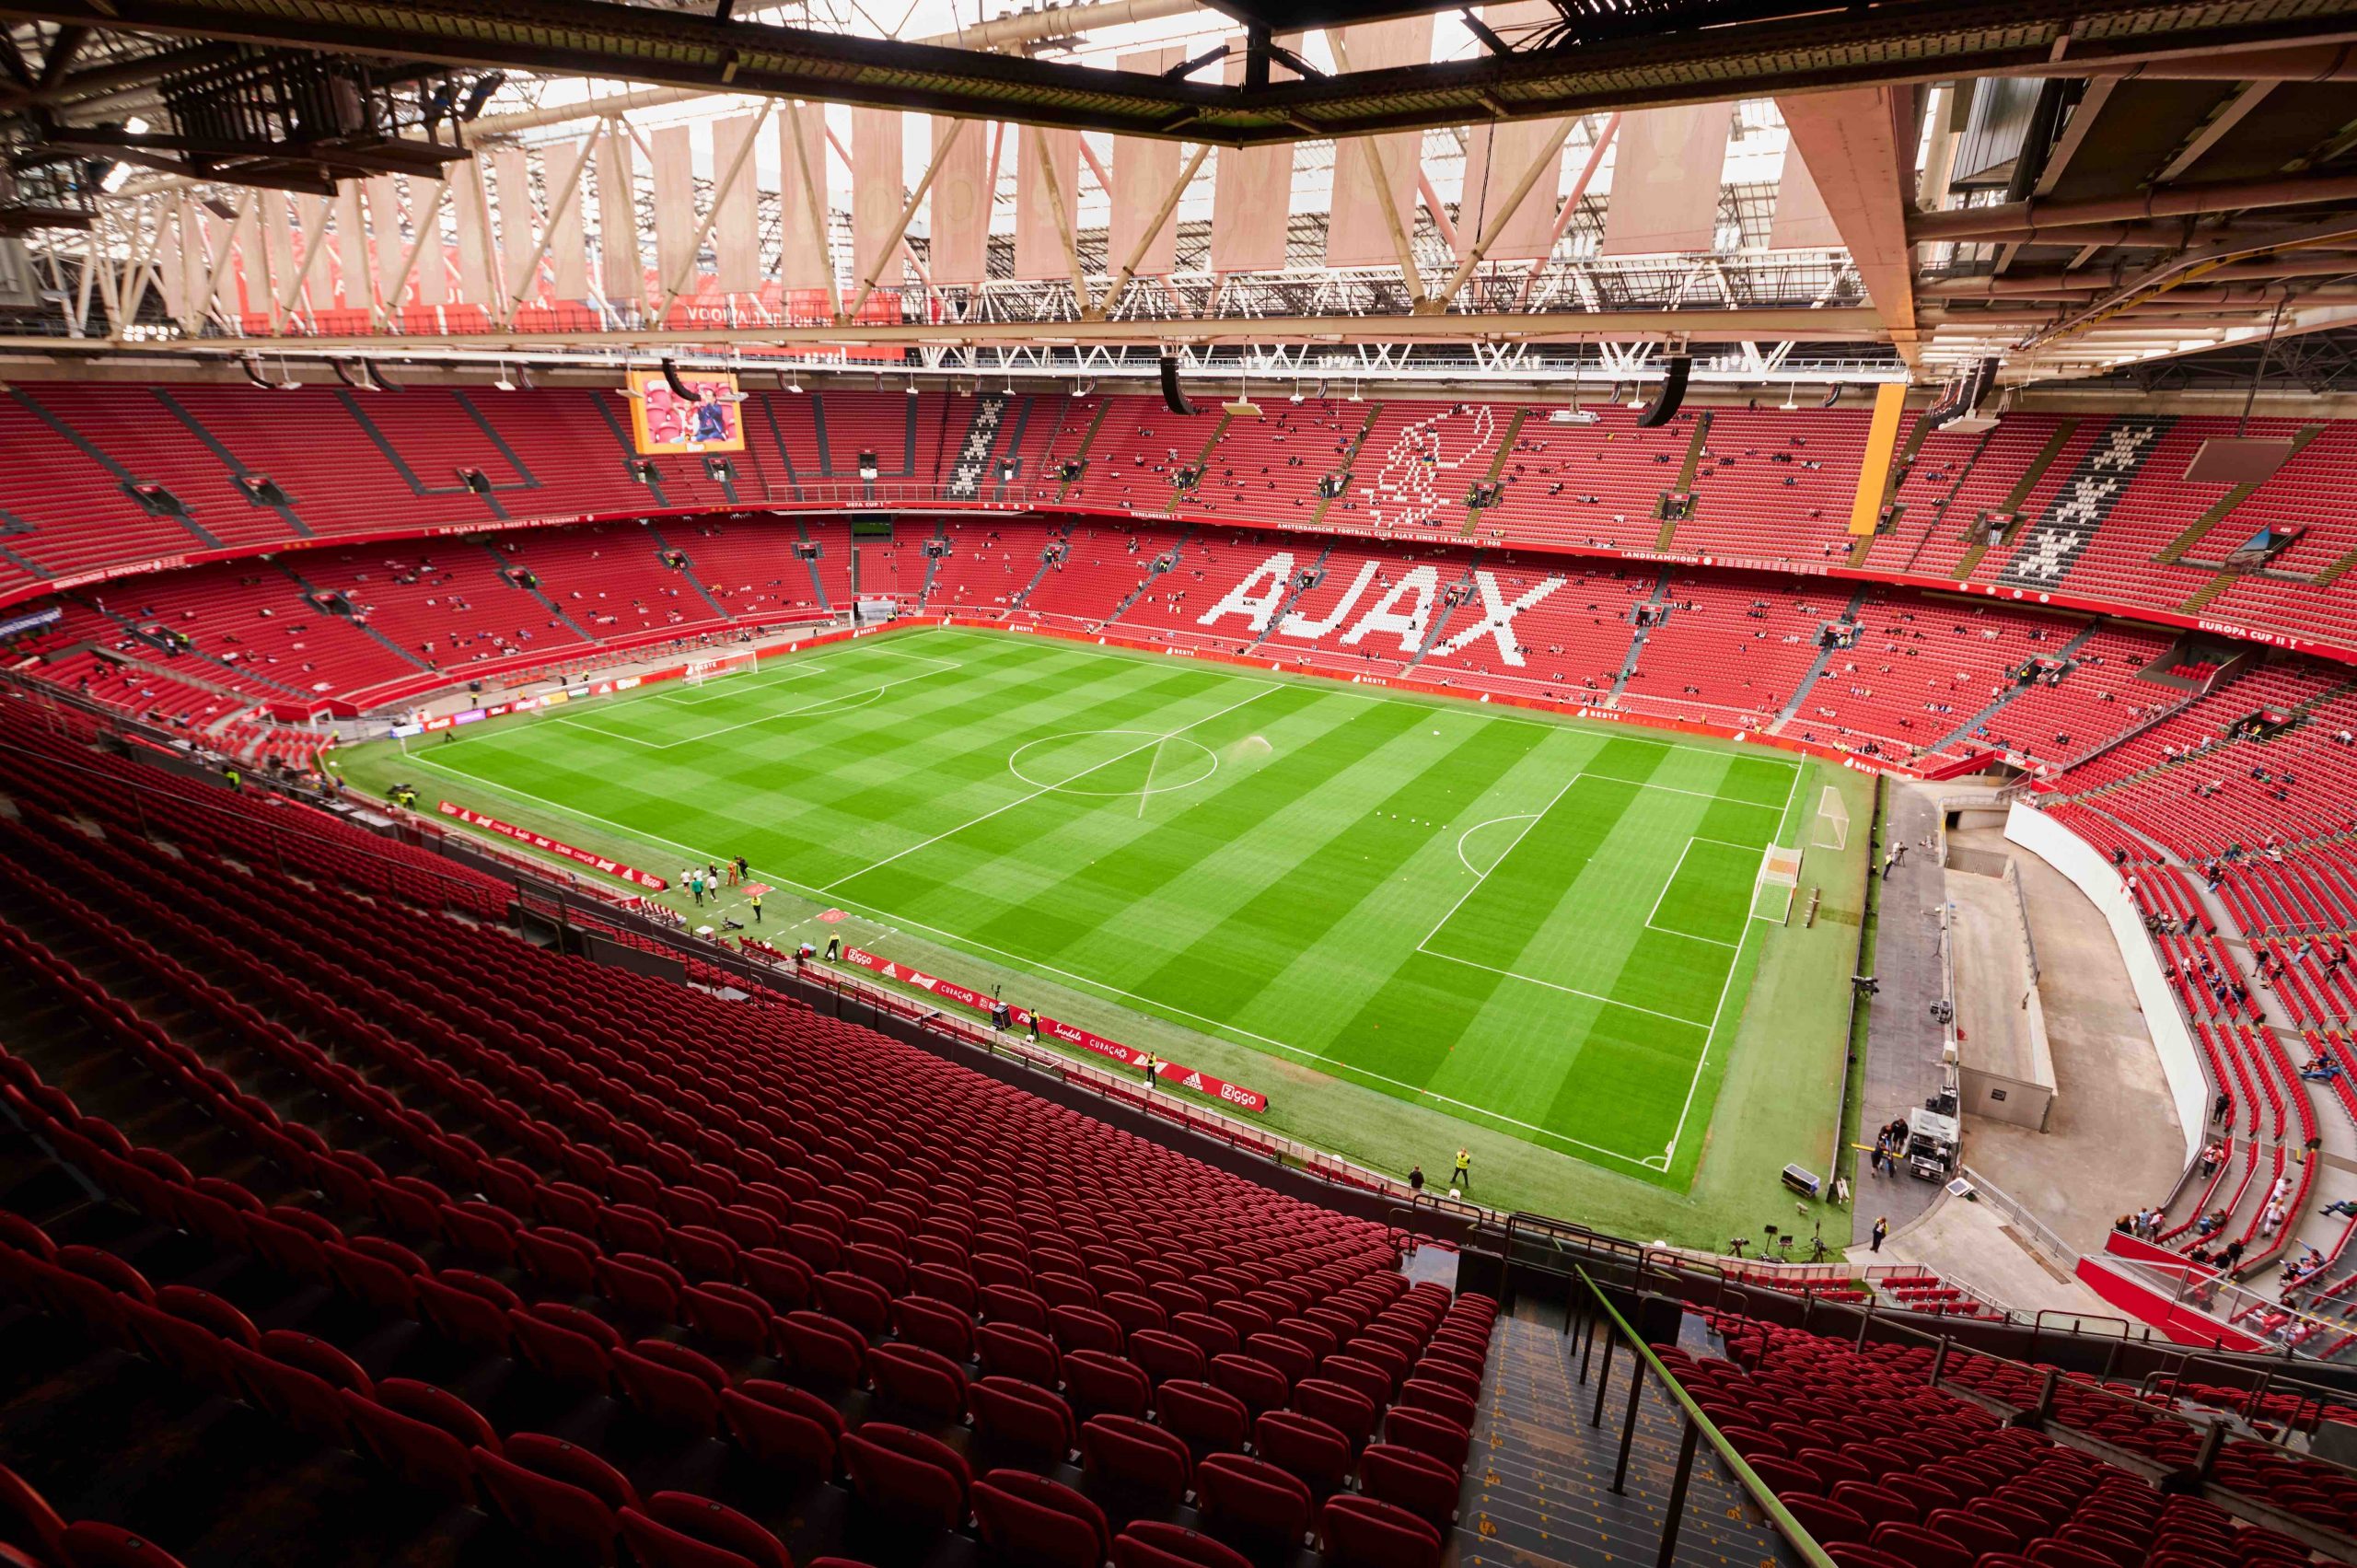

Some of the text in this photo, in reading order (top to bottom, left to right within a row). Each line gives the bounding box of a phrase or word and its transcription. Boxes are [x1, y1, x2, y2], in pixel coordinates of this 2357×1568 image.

[1337, 528, 1371, 537] FOOTBALL
[1374, 529, 1392, 538] CLUB
[1450, 537, 1478, 545] MAART
[1620, 551, 1699, 564] LANDSKAMPIOEN
[1196, 552, 1568, 668] AJAX
[2198, 620, 2247, 637] EUROPA
[2250, 631, 2272, 642] CUP
[1363, 676, 1387, 686] BESTE
[1590, 710, 1620, 720] BESTE
[1053, 1023, 1082, 1041] Sandals
[1182, 1079, 1203, 1091] adidas
[1221, 1083, 1257, 1105] Ziggo
